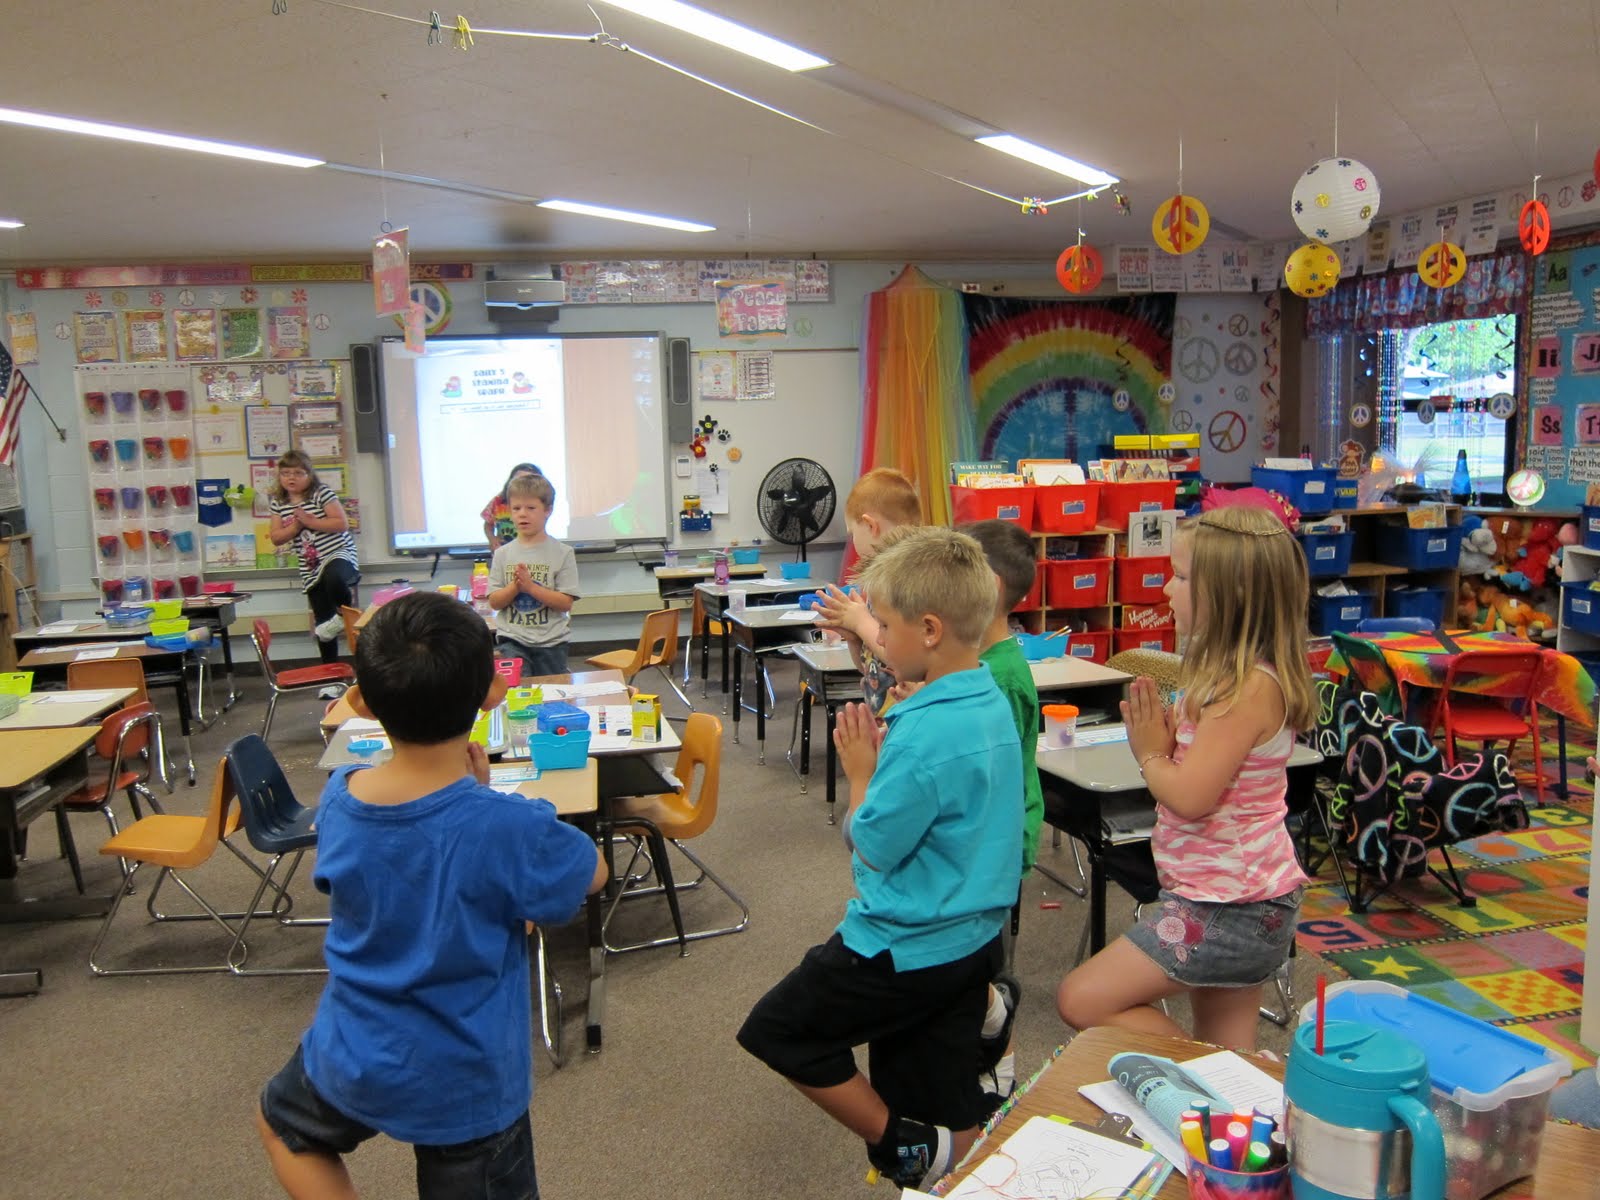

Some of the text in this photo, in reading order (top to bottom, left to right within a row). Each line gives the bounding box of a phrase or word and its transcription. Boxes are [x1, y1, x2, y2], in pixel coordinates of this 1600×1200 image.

[409, 265, 440, 278] EACE
[1548, 262, 1567, 282] Aa
[1538, 348, 1558, 368] Ii
[1541, 415, 1560, 434] Ss
[1529, 447, 1545, 456] said
[1571, 448, 1587, 457] take
[1570, 456, 1587, 467] that
[1570, 467, 1586, 477] their
[533, 564, 550, 573] INCH
[543, 572, 549, 586] A
[508, 605, 549, 626] YARD
